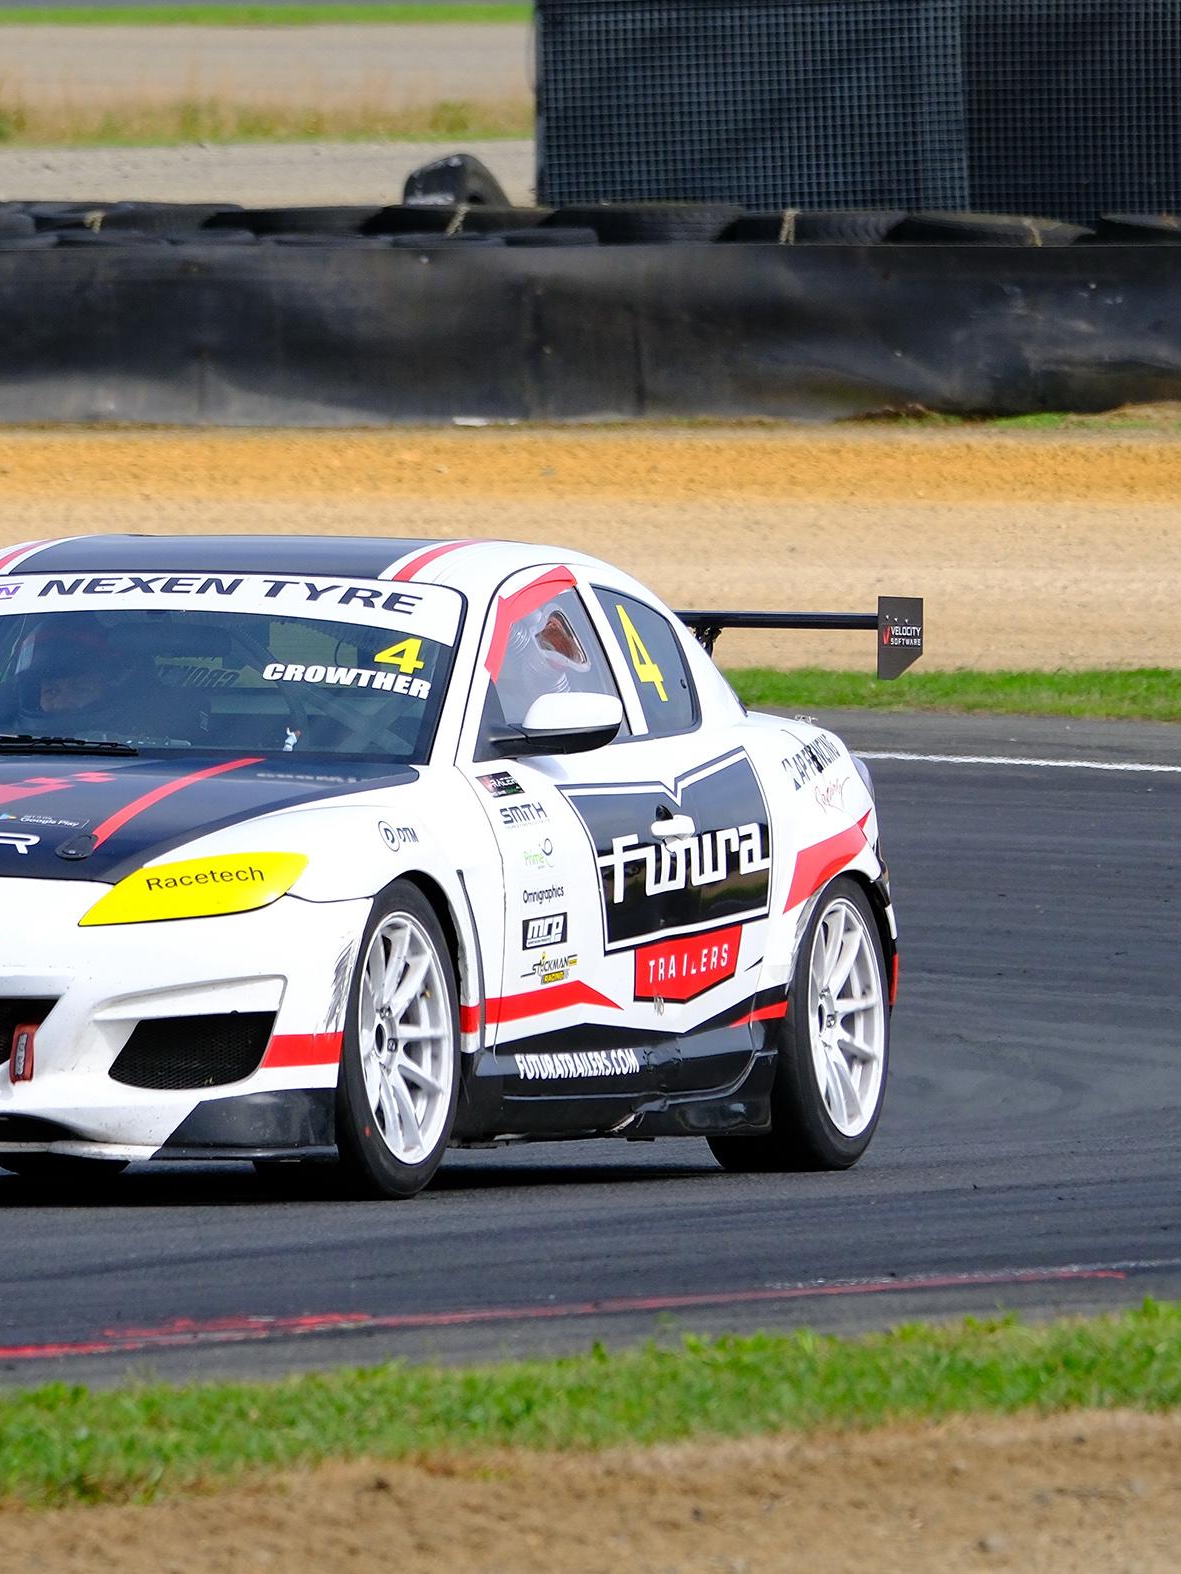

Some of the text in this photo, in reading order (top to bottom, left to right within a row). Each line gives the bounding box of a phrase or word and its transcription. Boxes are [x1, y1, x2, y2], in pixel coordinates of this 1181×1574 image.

[37, 576, 425, 615] NEXEN TYRE
[890, 626, 921, 636] VELOCITY
[890, 638, 921, 646] SOFTWARE
[373, 637, 425, 674] 4
[614, 604, 668, 702] 4
[262, 663, 432, 700] CROWTHER
[499, 801, 548, 825] SMITH
[146, 865, 266, 892] Racetech
[598, 822, 771, 904] Futura
[522, 884, 565, 904] Omnigraphics
[648, 943, 730, 984] TRAILERS
[514, 1048, 641, 1080] FUTURATRAILERS.COM
